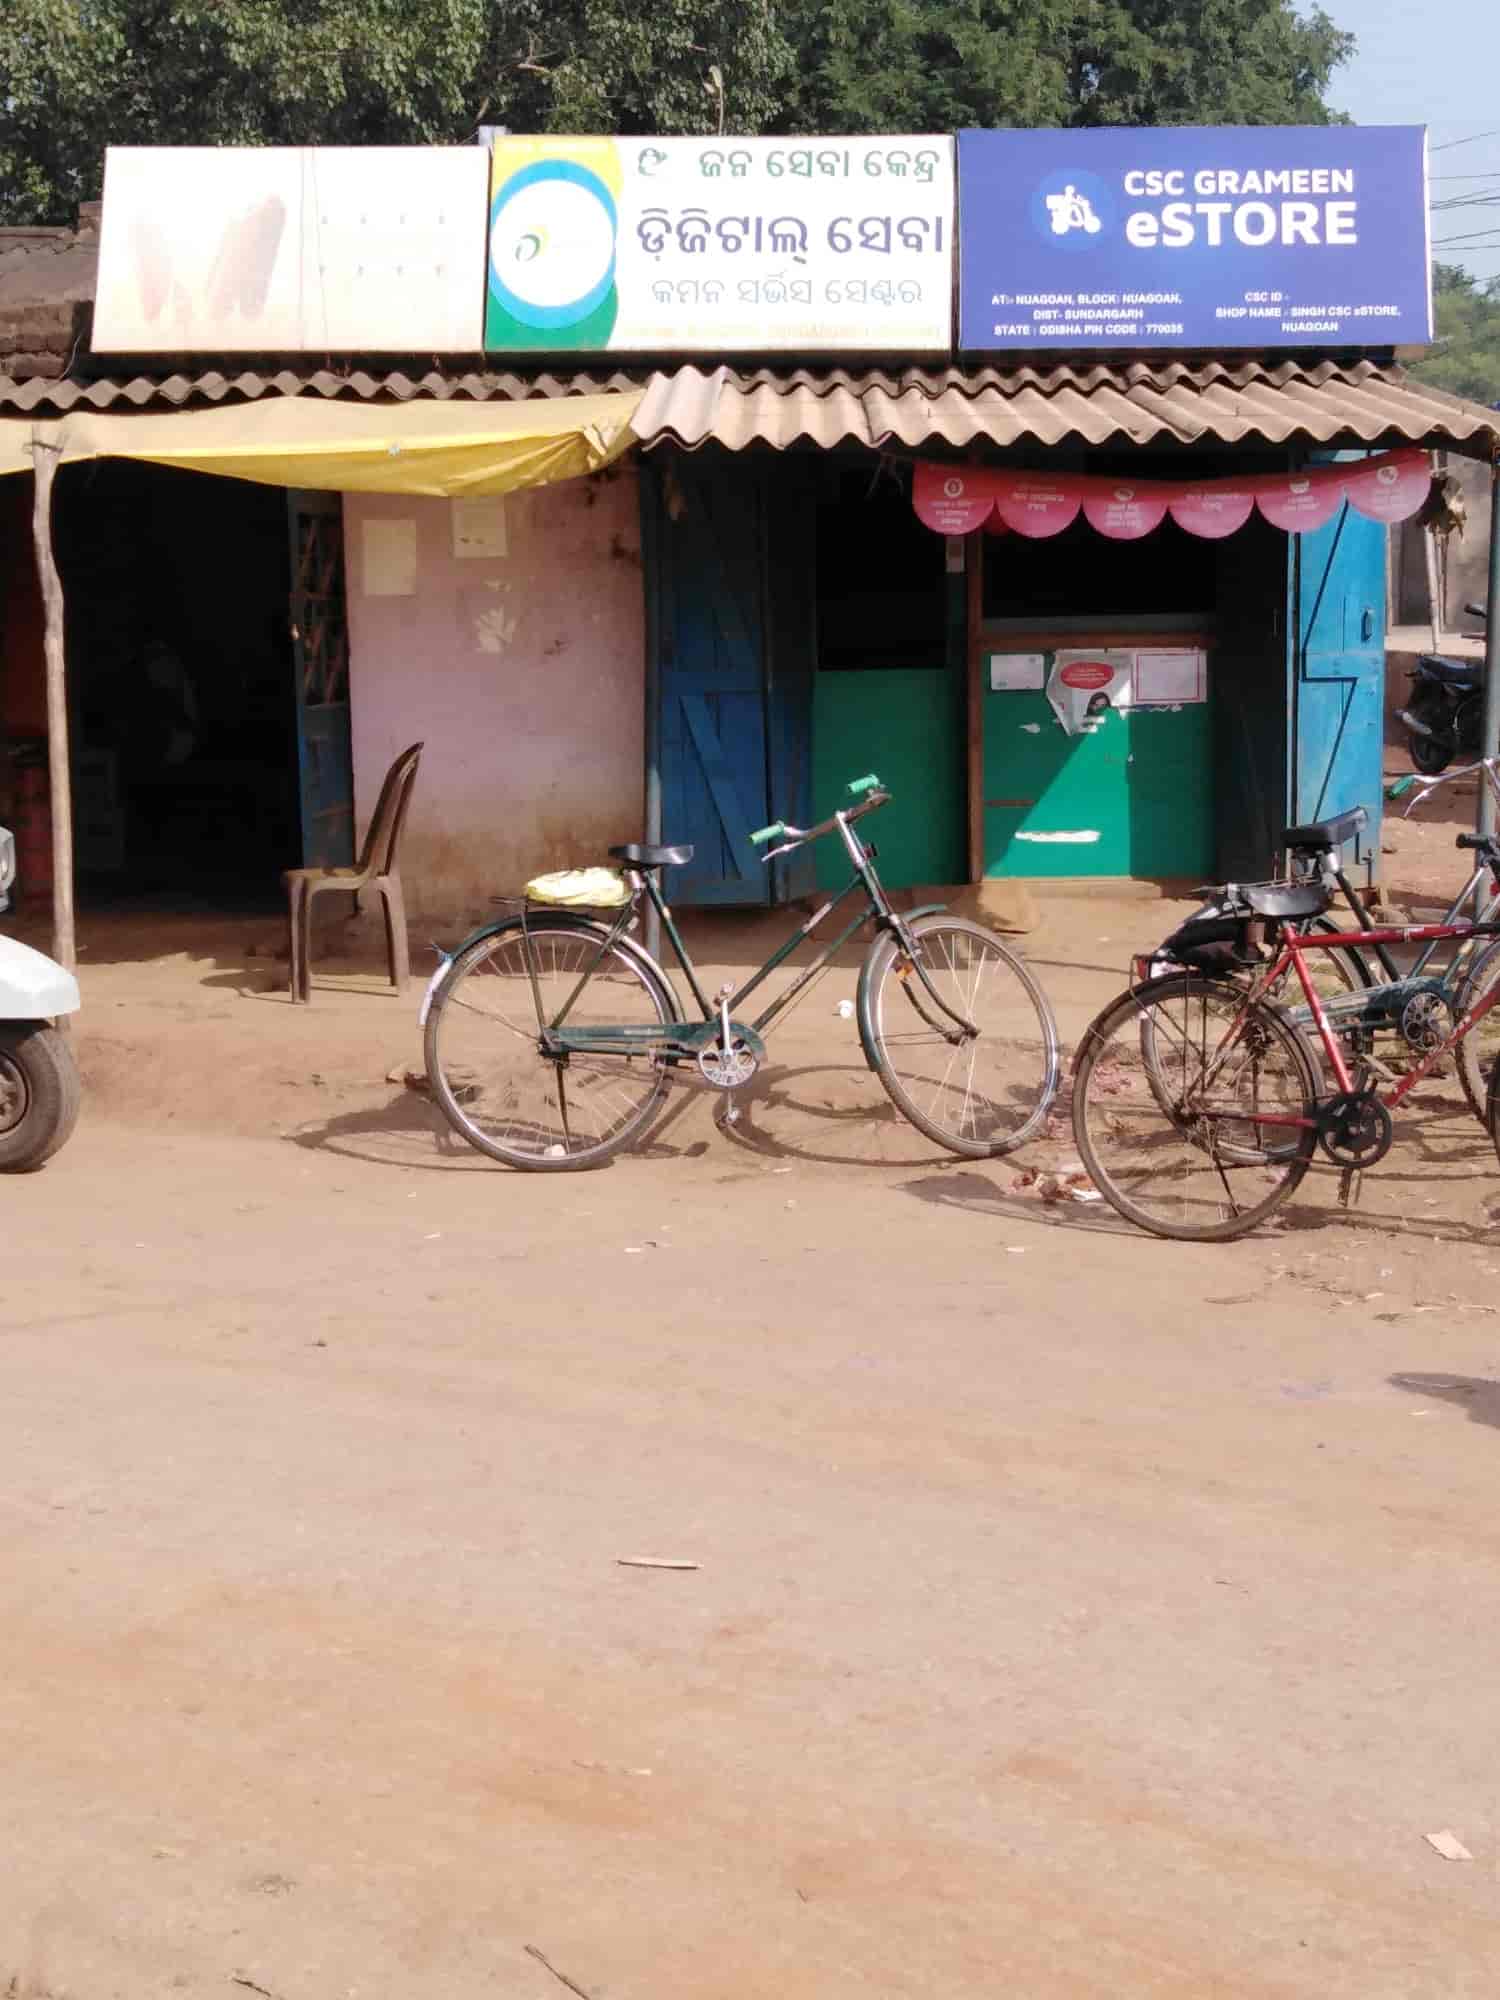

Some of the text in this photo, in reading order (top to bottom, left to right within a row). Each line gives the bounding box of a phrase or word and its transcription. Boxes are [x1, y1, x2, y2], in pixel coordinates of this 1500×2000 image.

[698, 149, 941, 182] ଜନ ସେବା କେନ୍ଦ୍ର
[1124, 168, 1354, 196] CSC GRAMEEN
[826, 215, 943, 254] ସେବା
[1125, 201, 1358, 248] eSTORE
[651, 279, 726, 304] କମନ
[1244, 291, 1269, 303] CSC
[1270, 291, 1283, 302] ID
[1215, 306, 1248, 318] SHOP
[1248, 306, 1282, 318] NAME
[1327, 305, 1352, 317] CSC
[1104, 323, 1137, 335] CODE
